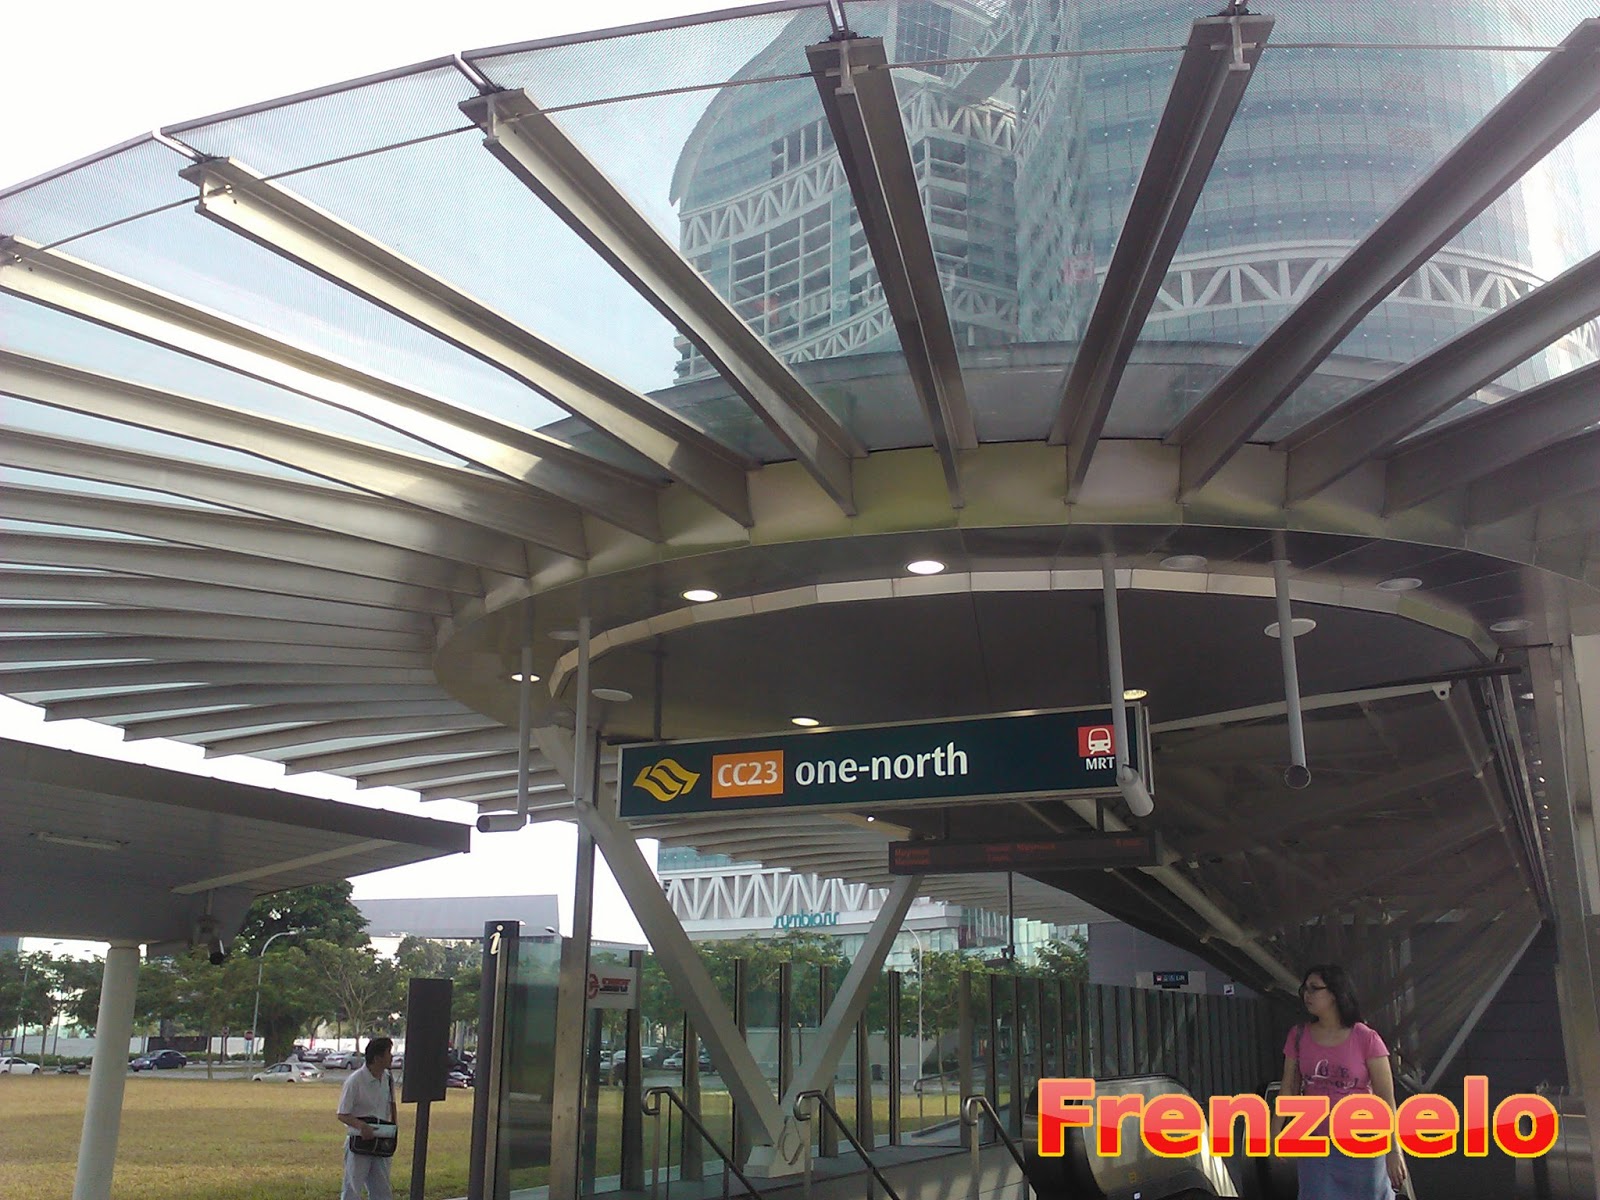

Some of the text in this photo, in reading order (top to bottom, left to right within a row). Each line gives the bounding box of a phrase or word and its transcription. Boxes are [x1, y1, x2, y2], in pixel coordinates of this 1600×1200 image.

[717, 741, 969, 788] CC23 one-north
[1085, 756, 1115, 770] MRT
